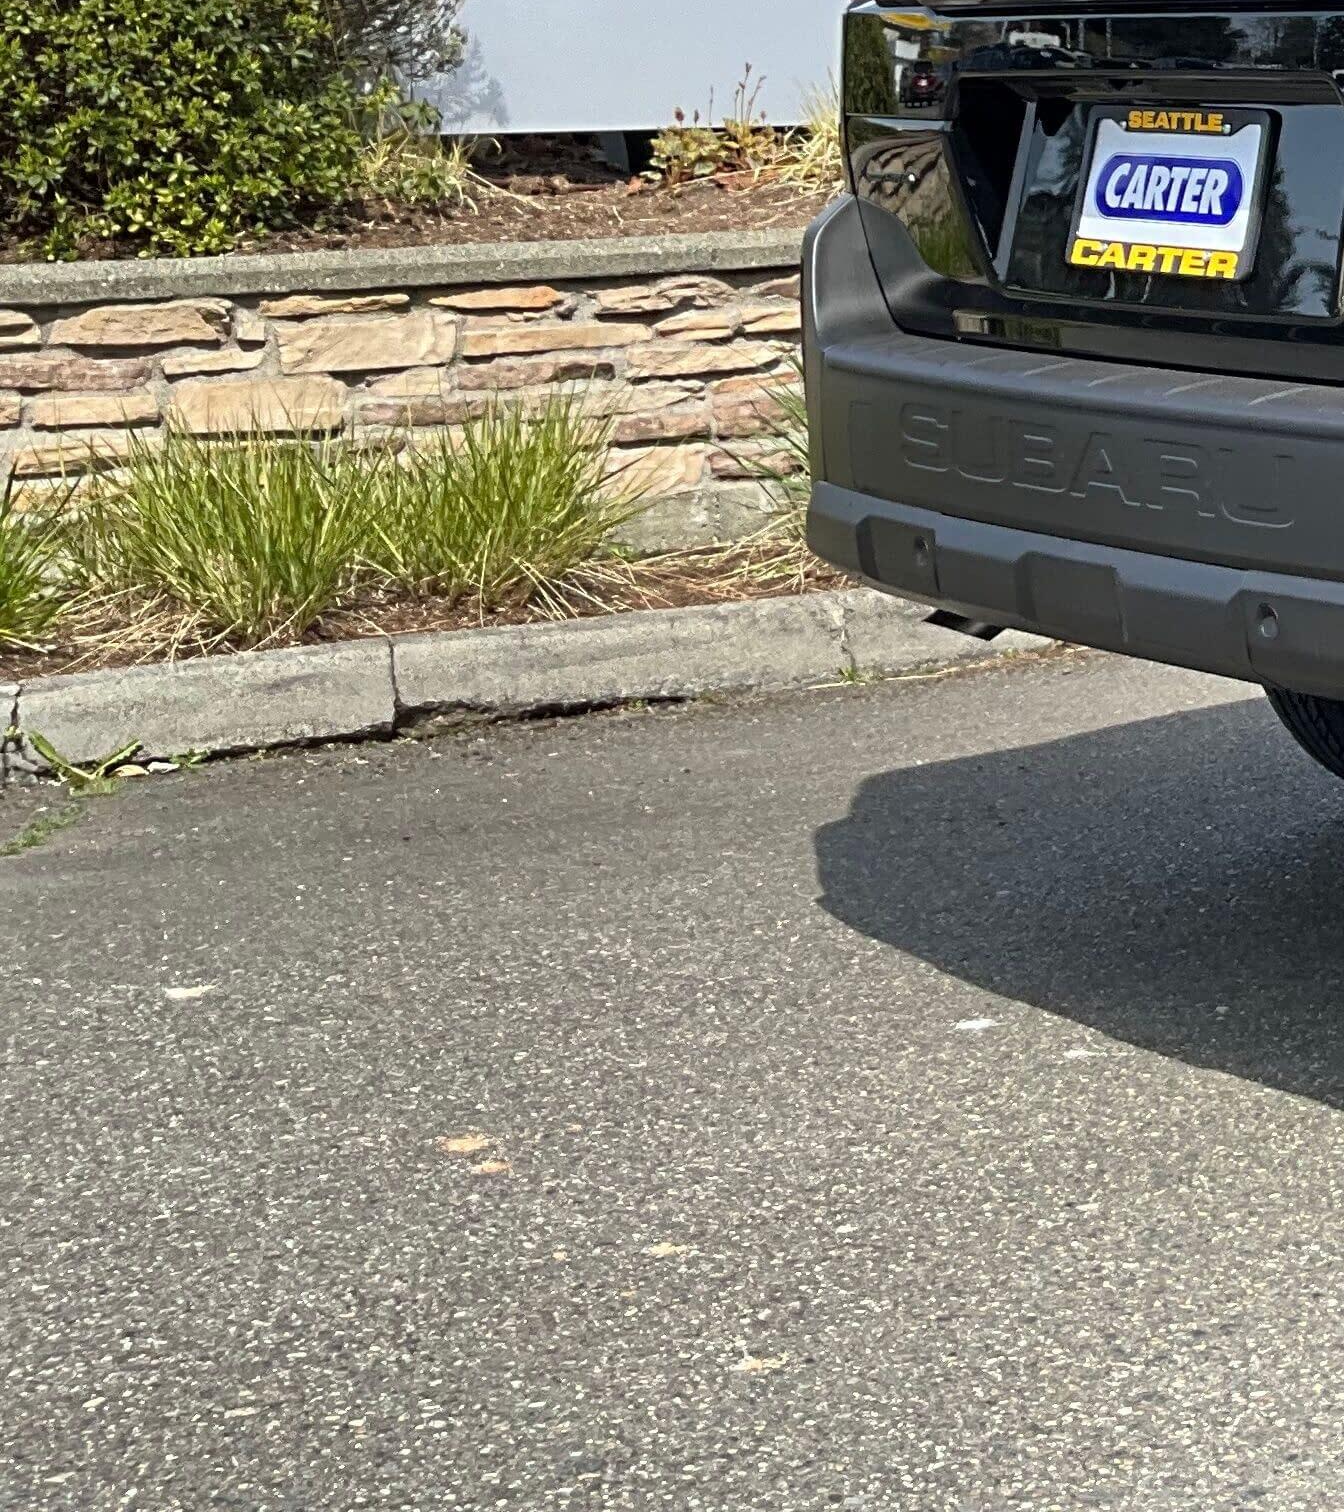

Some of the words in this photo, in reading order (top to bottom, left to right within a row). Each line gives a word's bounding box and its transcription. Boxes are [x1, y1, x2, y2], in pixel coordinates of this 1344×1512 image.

[1128, 110, 1224, 133] SEATTLE
[1104, 162, 1229, 216] CARTER
[1070, 238, 1239, 279] CARTER
[901, 402, 1294, 529] SUBARU
